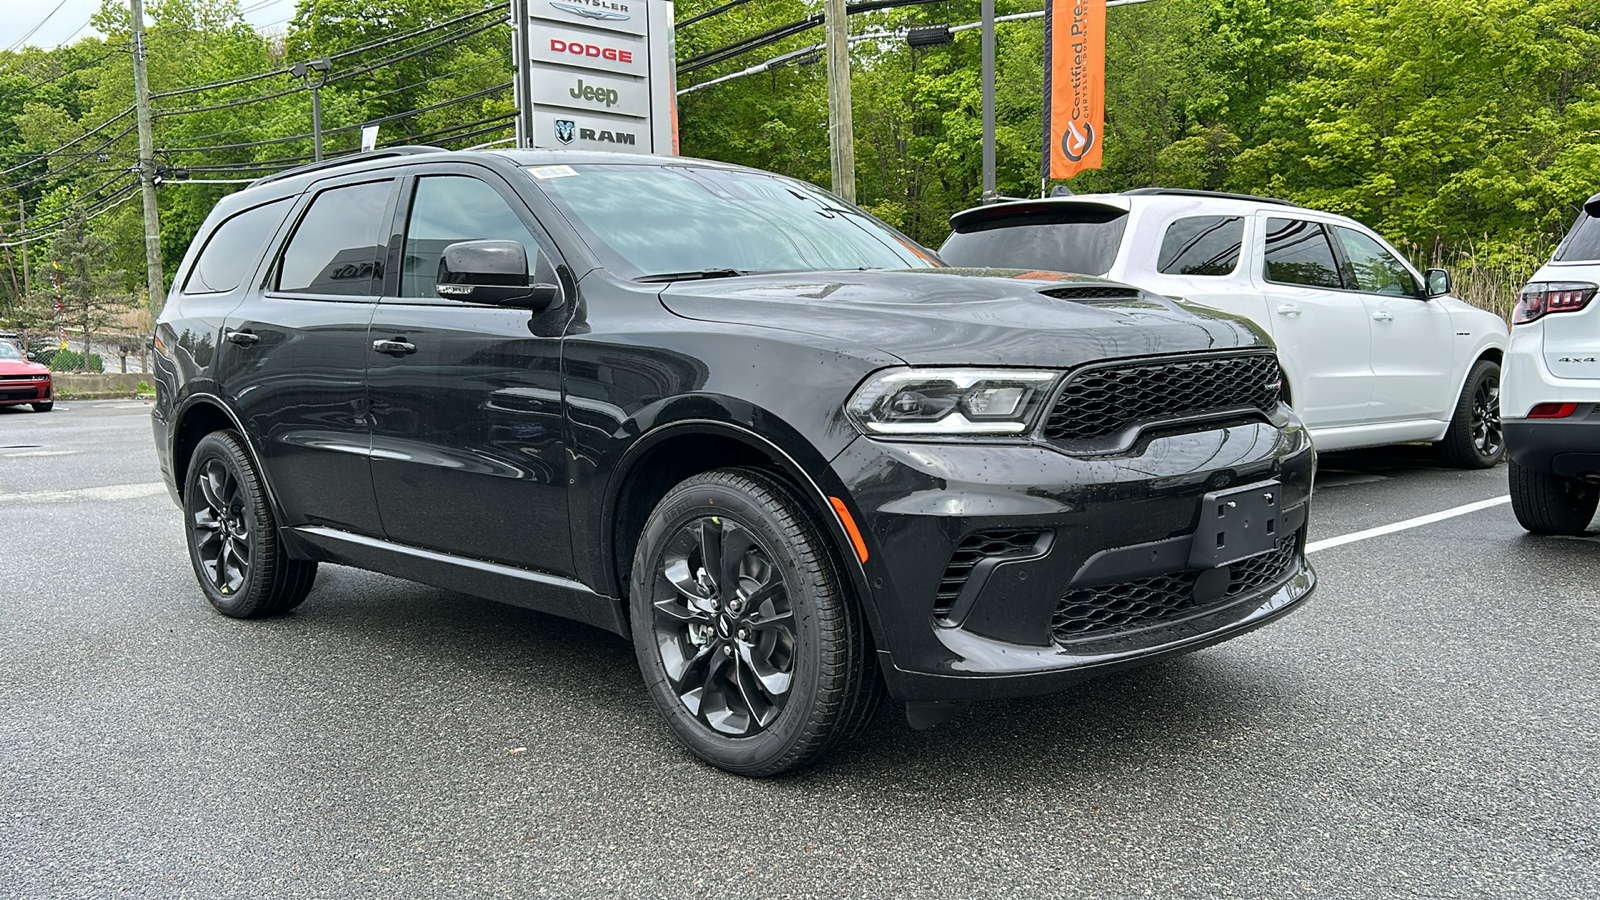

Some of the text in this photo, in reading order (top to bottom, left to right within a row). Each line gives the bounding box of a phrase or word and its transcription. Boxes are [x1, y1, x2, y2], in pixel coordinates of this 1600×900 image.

[550, 39, 632, 63] DODGE
[569, 79, 619, 107] Jeep
[1071, 42, 1083, 120] Certified
[579, 127, 636, 146] RAM
